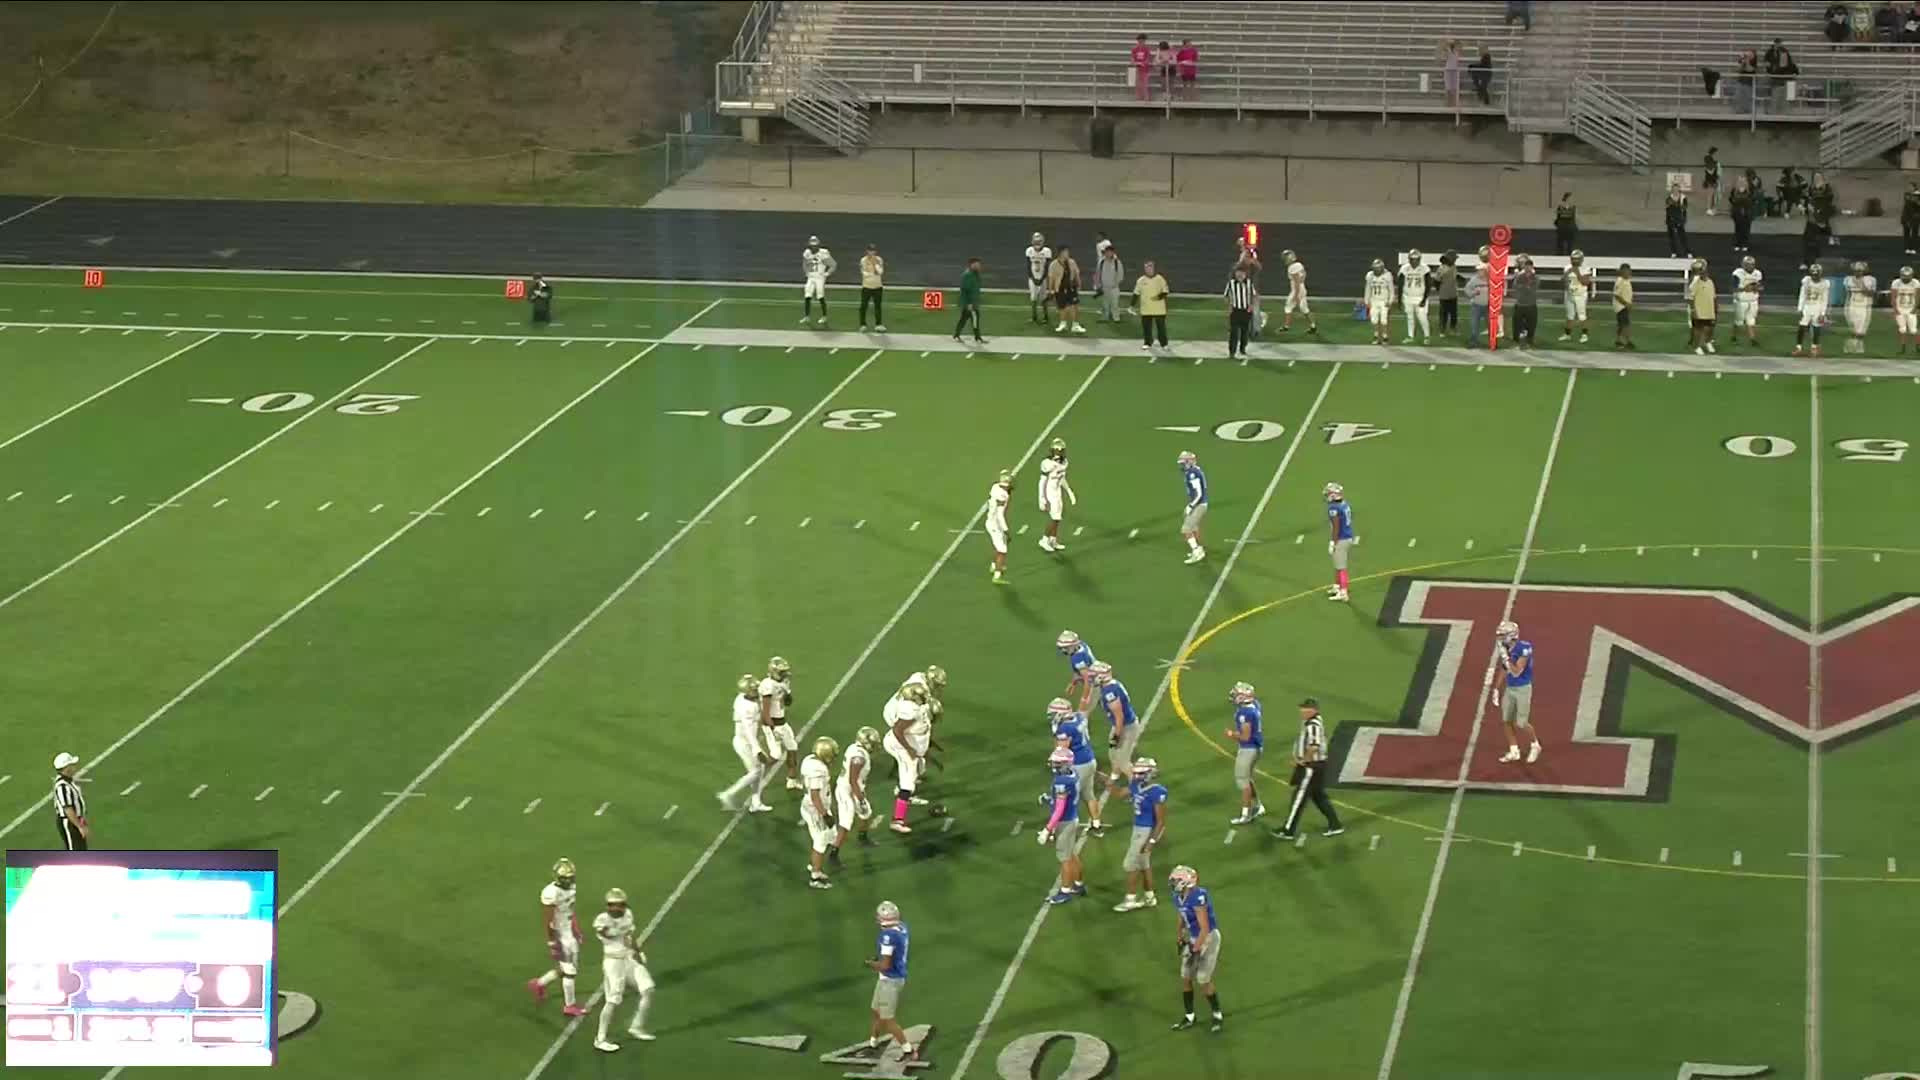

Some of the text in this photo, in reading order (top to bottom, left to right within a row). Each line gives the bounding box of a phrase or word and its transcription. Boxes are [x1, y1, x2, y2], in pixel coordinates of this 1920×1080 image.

[1248, 224, 1257, 245] 1
[925, 293, 941, 307] 30
[241, 392, 422, 415] 20
[721, 405, 897, 430] 30
[1215, 420, 1392, 445] 40
[1725, 435, 1909, 462] 50
[819, 1024, 1110, 1080] 40
